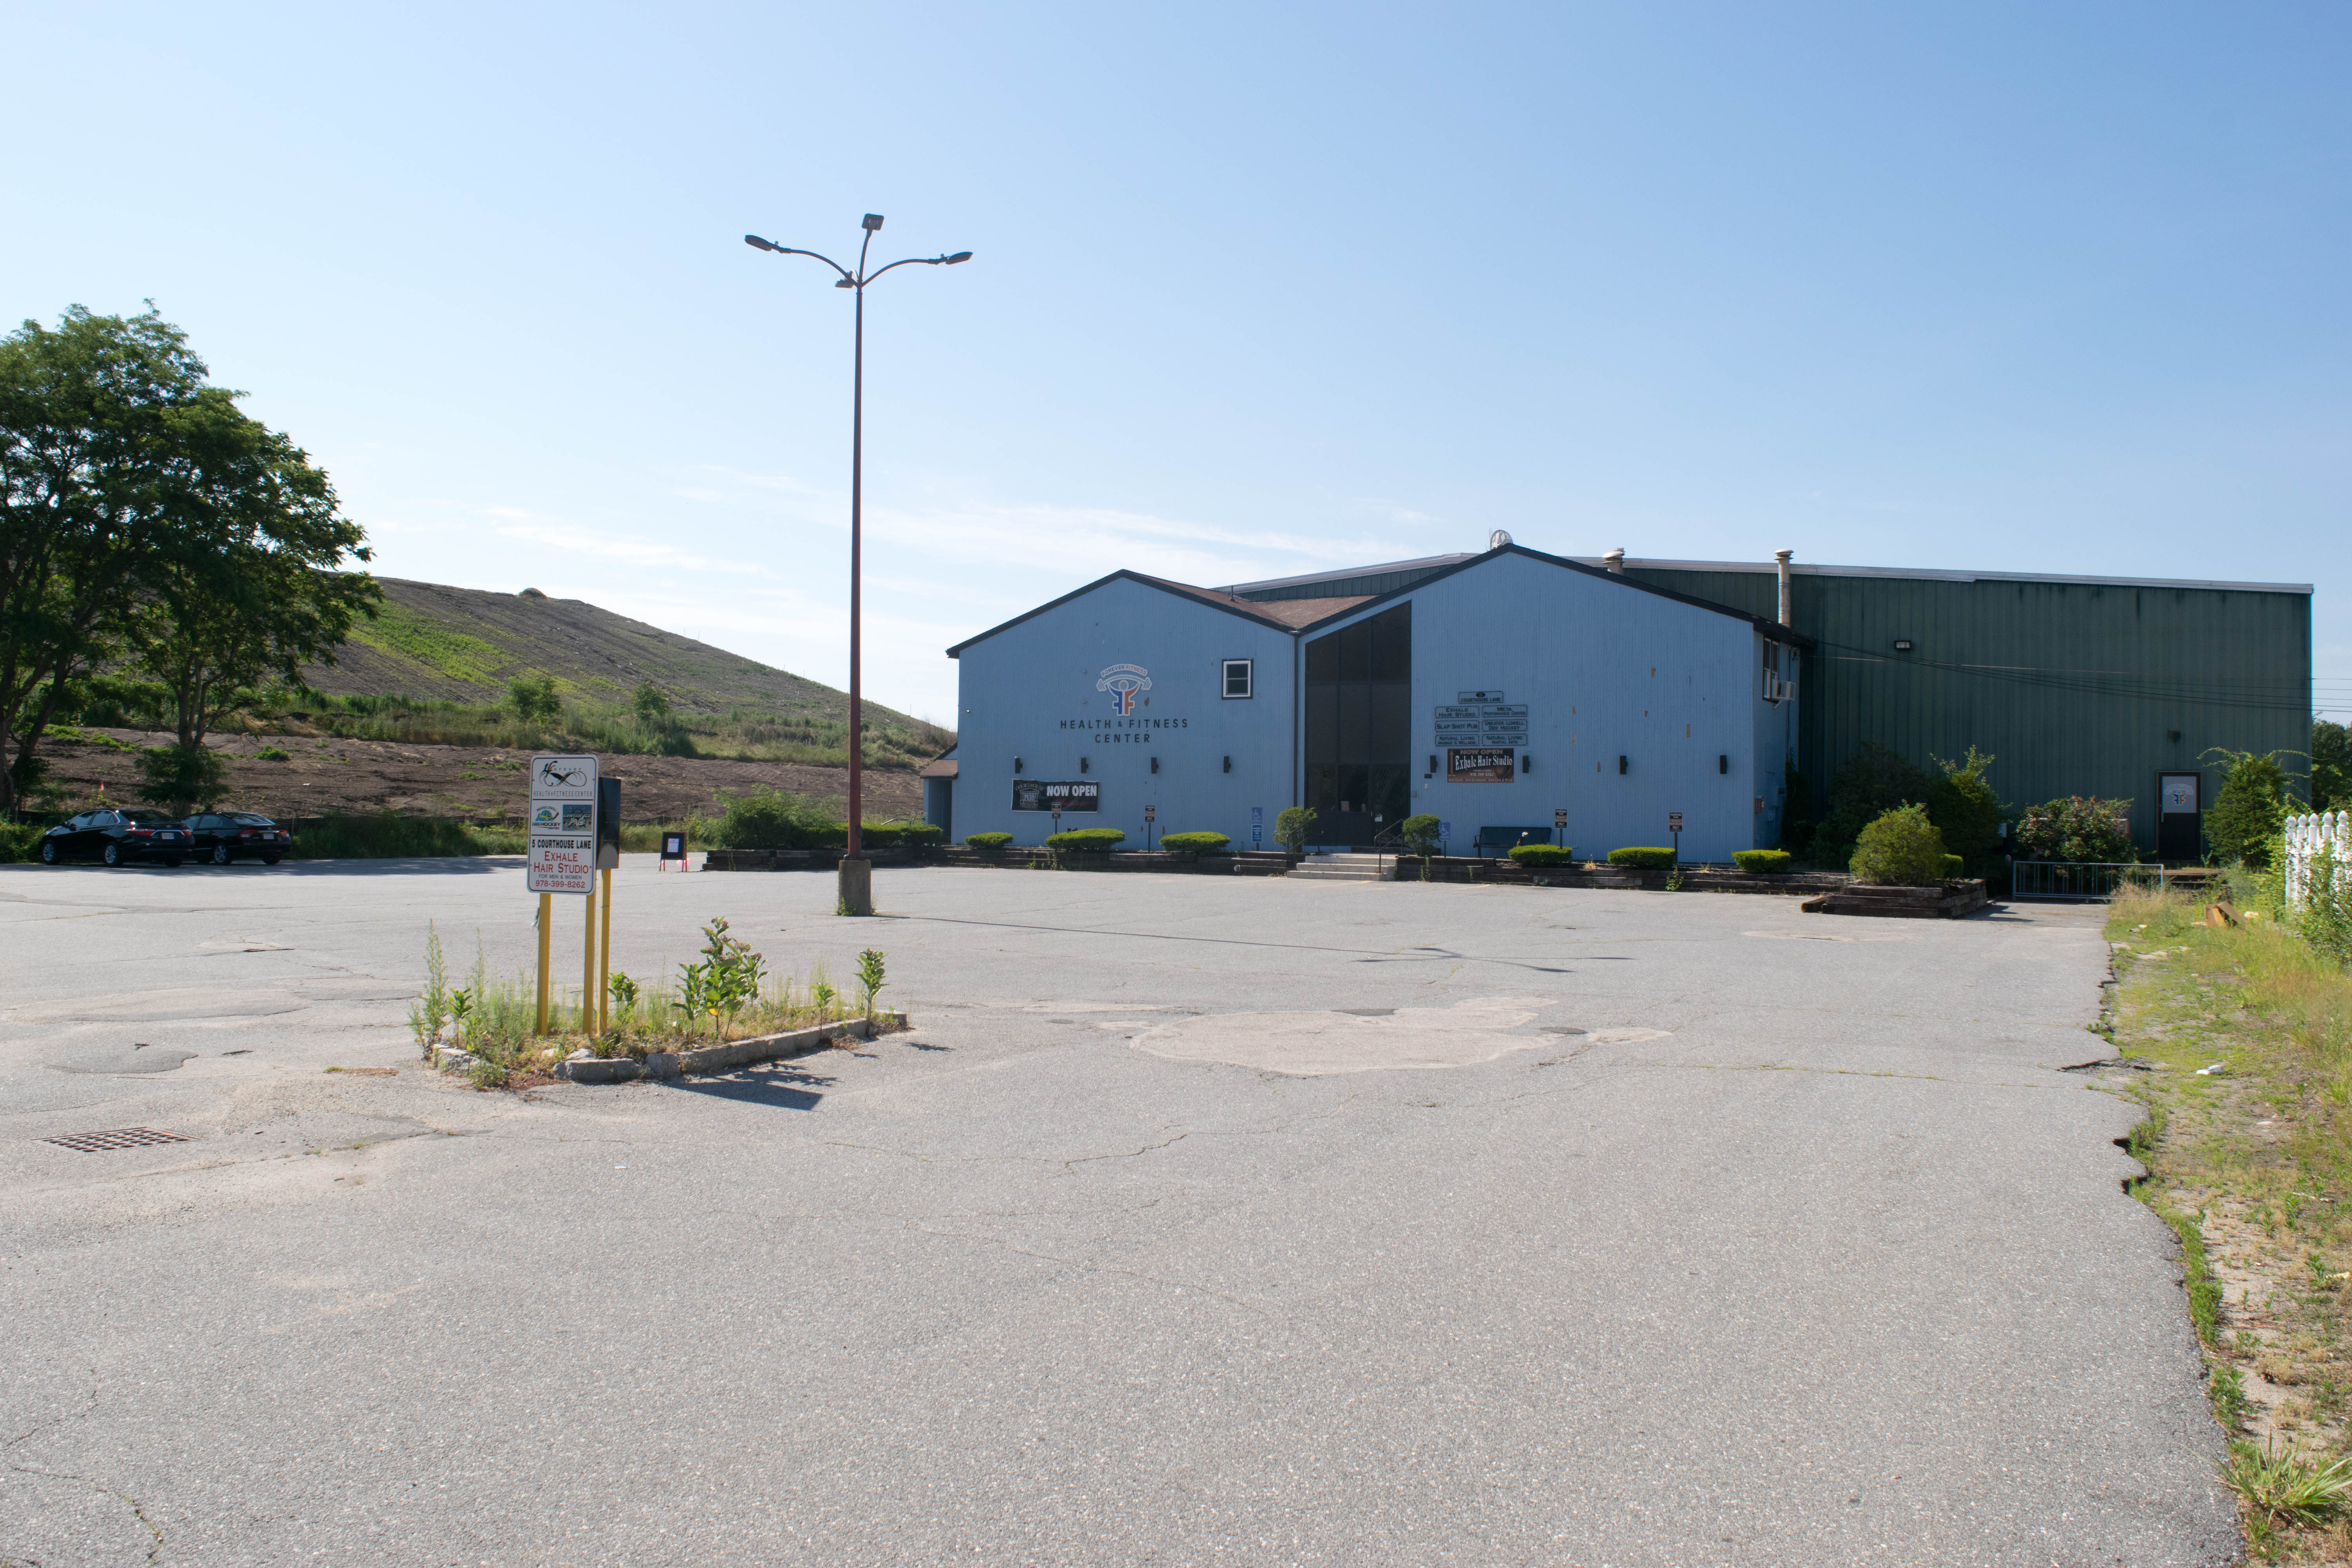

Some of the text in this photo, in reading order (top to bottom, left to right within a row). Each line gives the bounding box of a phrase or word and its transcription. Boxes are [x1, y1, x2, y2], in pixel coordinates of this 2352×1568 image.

[1102, 665, 1147, 677] FOREVER FITNESS
[1060, 720, 1111, 729] HEALTH
[1129, 719, 1188, 728] FITNESS
[1095, 734, 1150, 743] CENTER
[1455, 755, 1512, 771] Exhale Hair Studio
[1015, 783, 1044, 791] COURTHOUSE
[1046, 785, 1097, 797] NOW OPEN
[532, 839, 592, 849] 5 COURTHOUSE LANE
[544, 851, 578, 862] EXHALE
[534, 862, 589, 874] HAIR STUDIO
